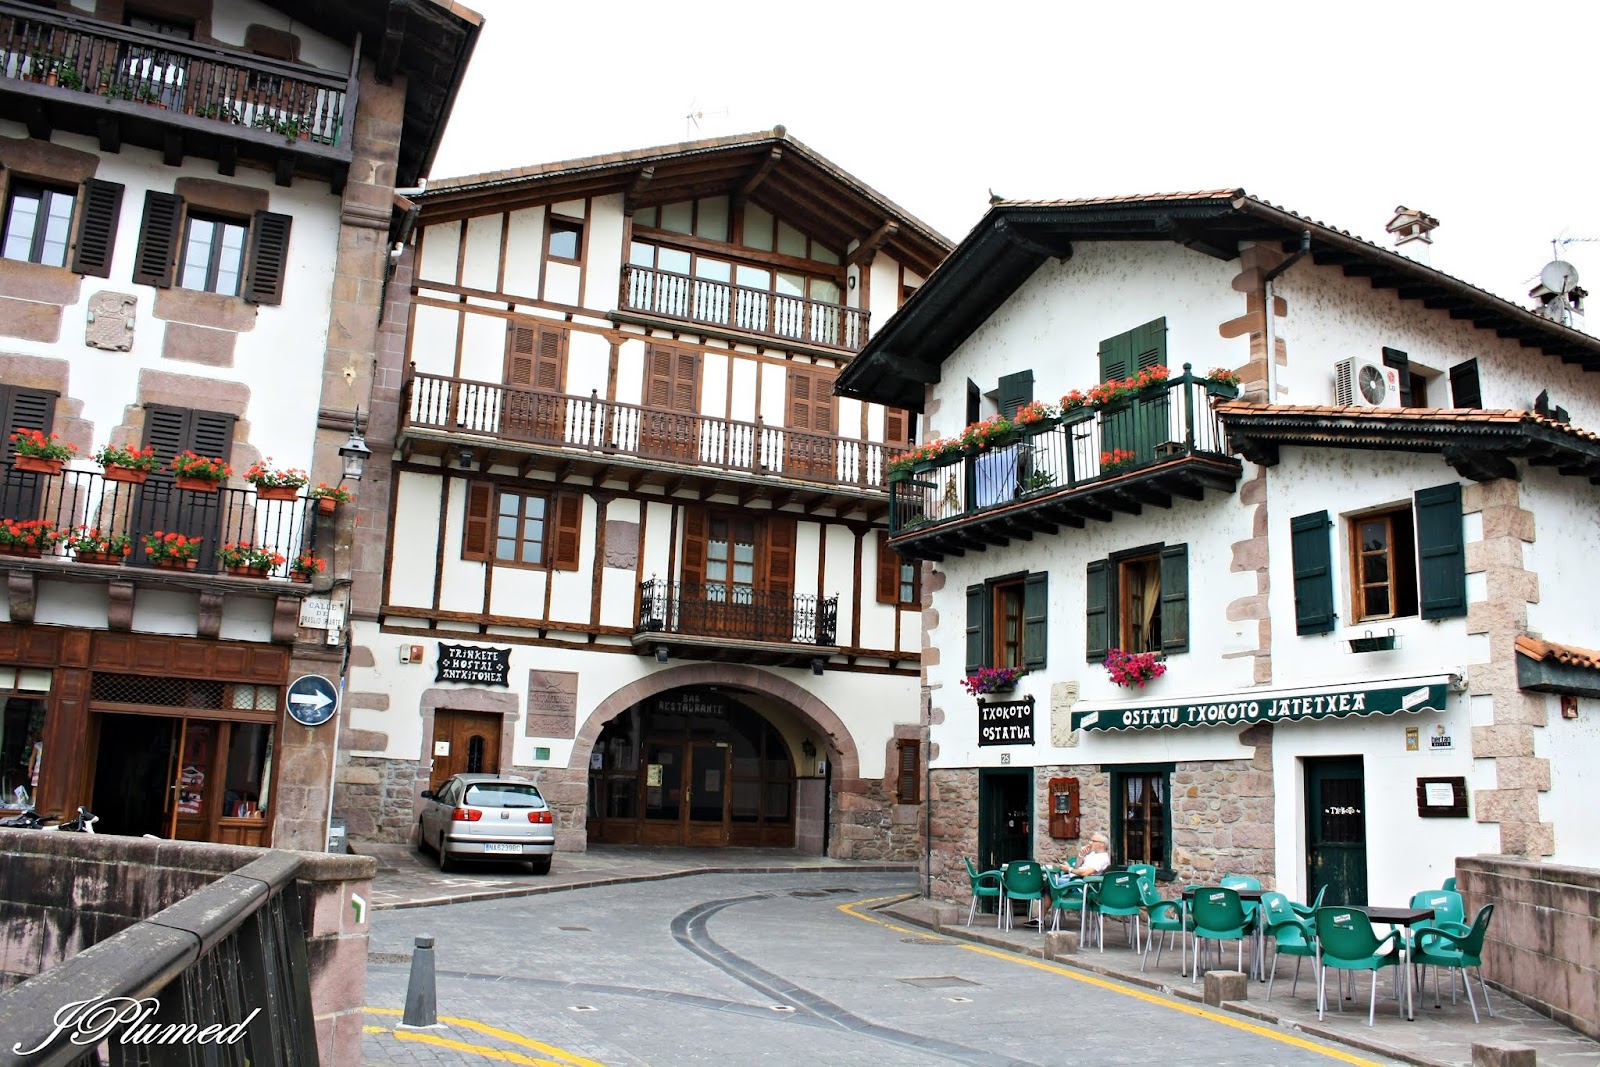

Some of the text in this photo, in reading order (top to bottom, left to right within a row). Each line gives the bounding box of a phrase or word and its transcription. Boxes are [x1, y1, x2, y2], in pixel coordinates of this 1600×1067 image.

[452, 659, 493, 671] HOSTAL
[683, 694, 700, 703] BAR
[658, 700, 723, 714] RESTAURANTE
[982, 705, 1031, 720] TXOKOTO
[1122, 708, 1179, 725] OSTATU
[1187, 701, 1259, 722] TXOKOTO
[1268, 692, 1366, 716] JATETXEA
[982, 725, 1031, 740] OSTATUA
[1002, 754, 1010, 763] 25
